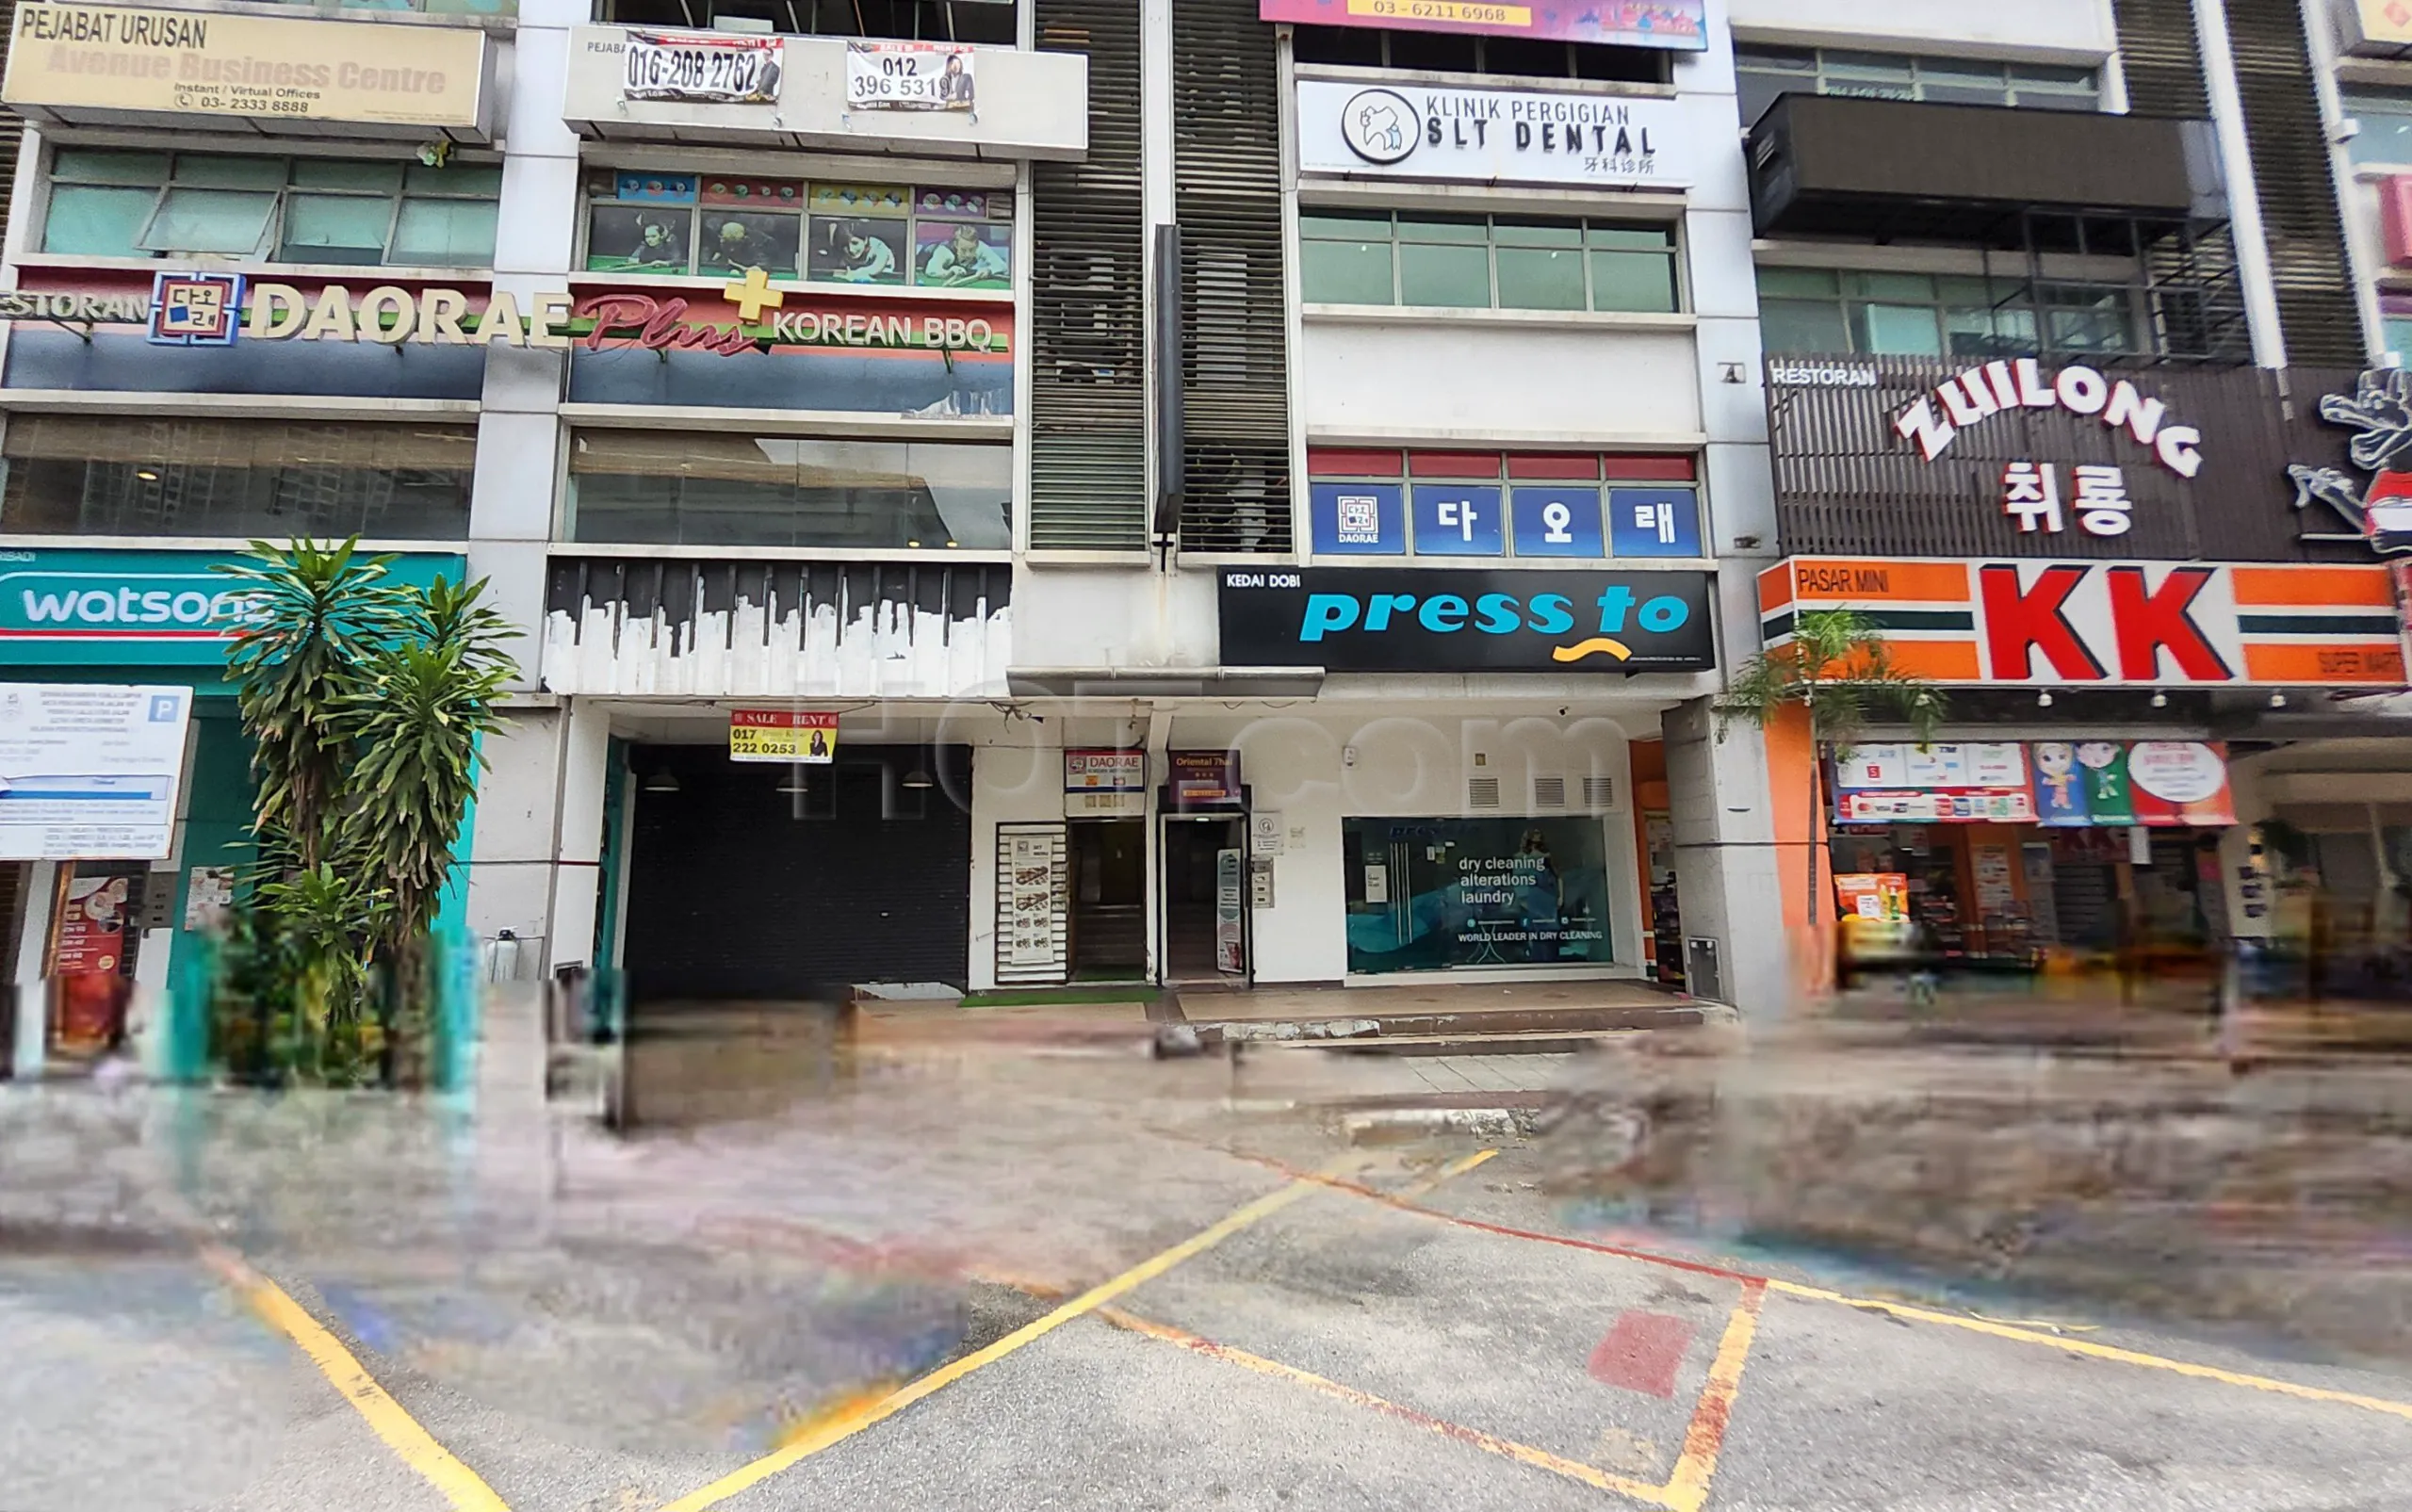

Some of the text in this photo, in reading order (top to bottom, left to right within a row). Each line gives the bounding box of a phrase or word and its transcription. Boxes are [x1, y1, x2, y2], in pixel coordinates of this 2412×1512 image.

[1373, 0, 1396, 13] 03
[1412, 5, 1457, 19] 6211
[1461, 6, 1507, 22] 6968
[21, 8, 207, 49] PEJABAT URUSAN
[48, 46, 447, 94] Avenue Business Centre
[709, 51, 757, 92] 2762
[883, 57, 918, 77] 012
[173, 82, 220, 95] Instant
[230, 86, 272, 98] Virtual
[276, 88, 321, 100] Offices
[855, 75, 951, 101] 396 5319
[230, 98, 268, 110] 2333
[271, 100, 309, 113] 8888
[1426, 95, 1630, 125] KLINIK PERGIGIAN
[1427, 117, 1656, 155] SLT DENTAL
[1584, 157, 1655, 174] 牙科诊所
[0, 283, 575, 350] STORAN DAORAE
[773, 311, 912, 346] KOREAN
[923, 317, 993, 353] BBQ
[1772, 367, 1877, 386] RESTORAN
[1339, 534, 1379, 544] DAORAE
[1227, 574, 1301, 588] KEDAI DOBI
[1798, 568, 1889, 593] PASAR MINI
[1979, 563, 2237, 681] KK
[746, 713, 826, 724] SALE RENT
[732, 729, 758, 740] 017
[732, 742, 796, 755] 222 0253
[1089, 756, 1139, 768] DAORAE
[1176, 756, 1213, 767] Oriental
[1459, 856, 1546, 872] dry cleaning
[1460, 873, 1537, 886] alterations
[1461, 889, 1515, 905] laundry
[1458, 931, 1603, 942] WORLD LEADER IN DRY CLEANING
